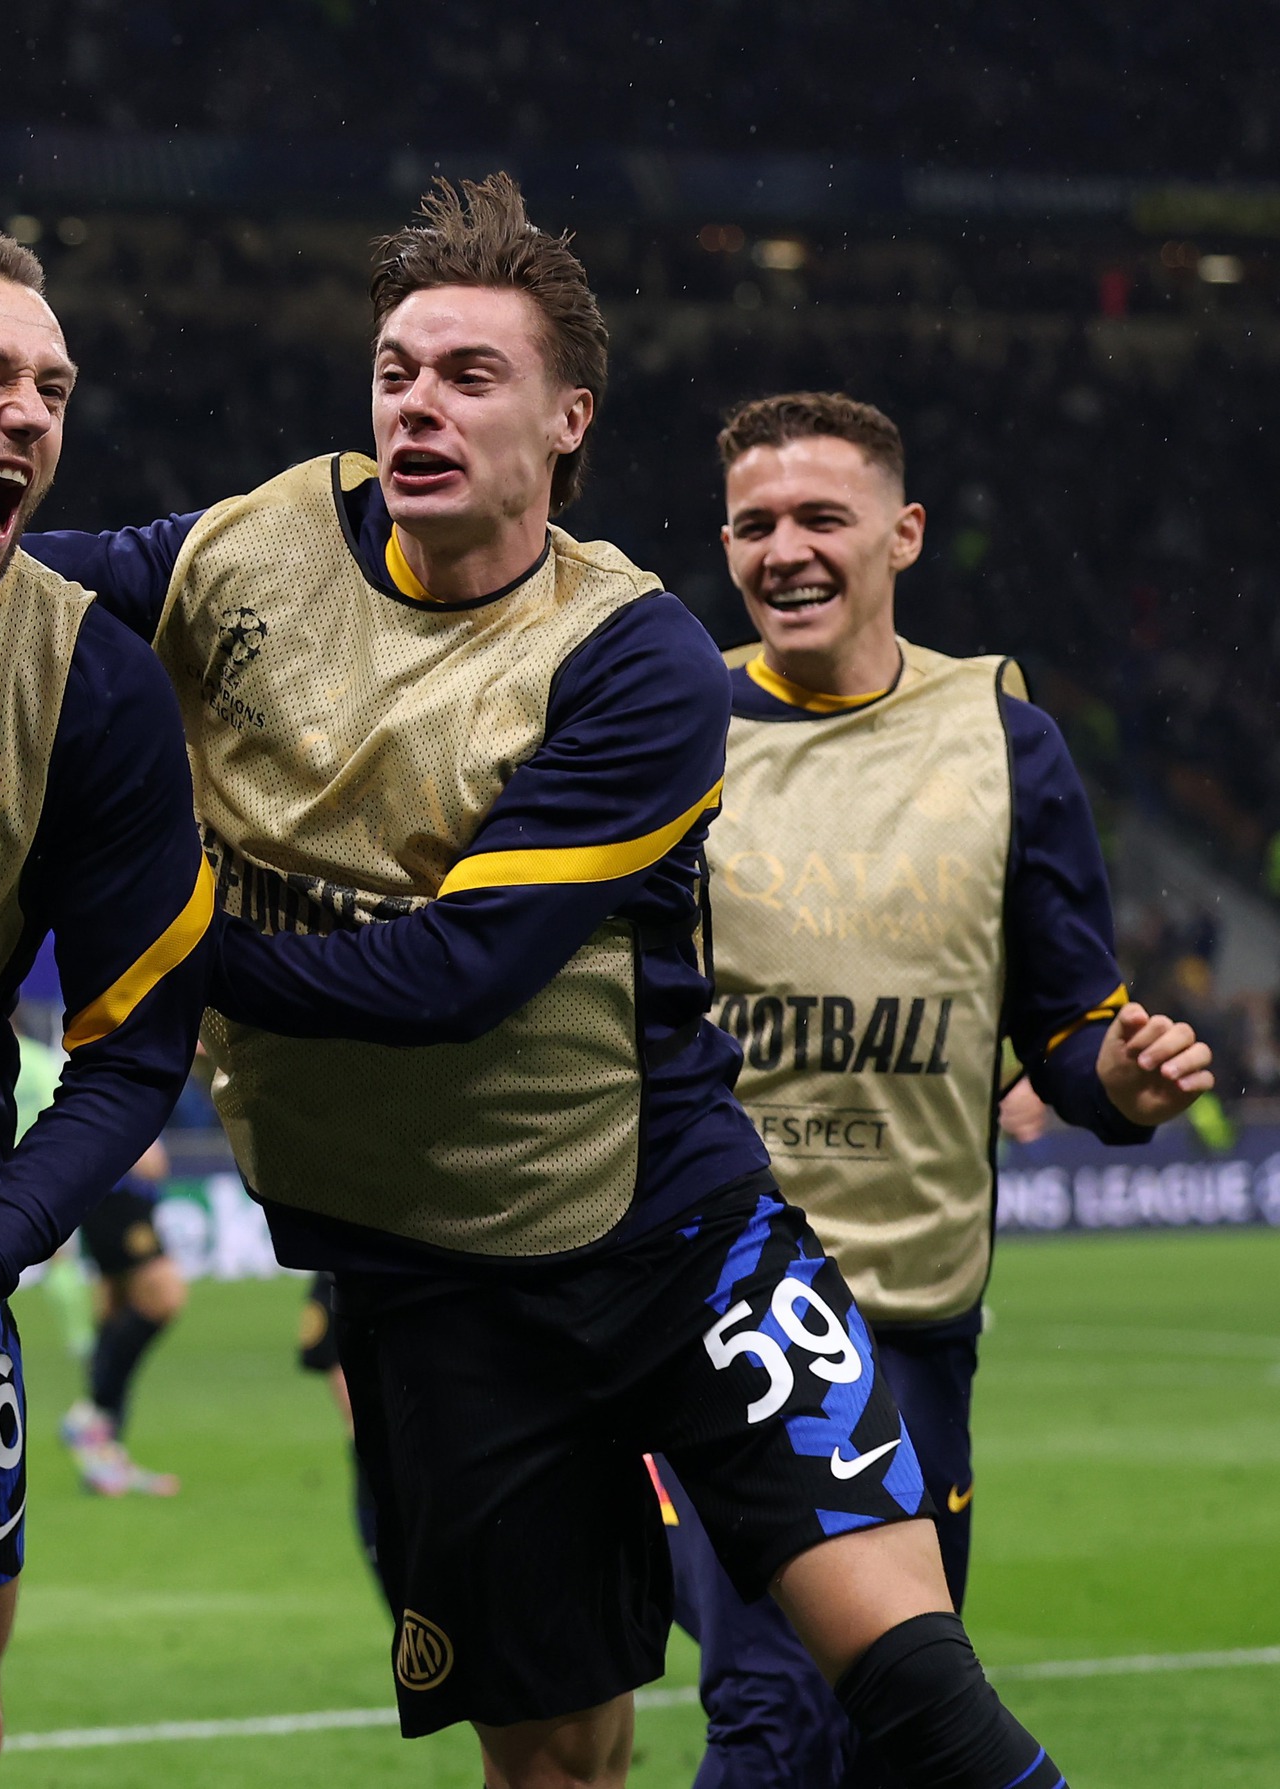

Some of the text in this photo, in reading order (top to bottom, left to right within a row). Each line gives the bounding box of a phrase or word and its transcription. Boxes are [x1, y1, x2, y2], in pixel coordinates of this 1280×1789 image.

[722, 850, 972, 911] QATAR
[713, 994, 953, 1074] OOTBALL
[753, 1115, 889, 1150] ESPECT
[702, 1277, 862, 1424] 59
